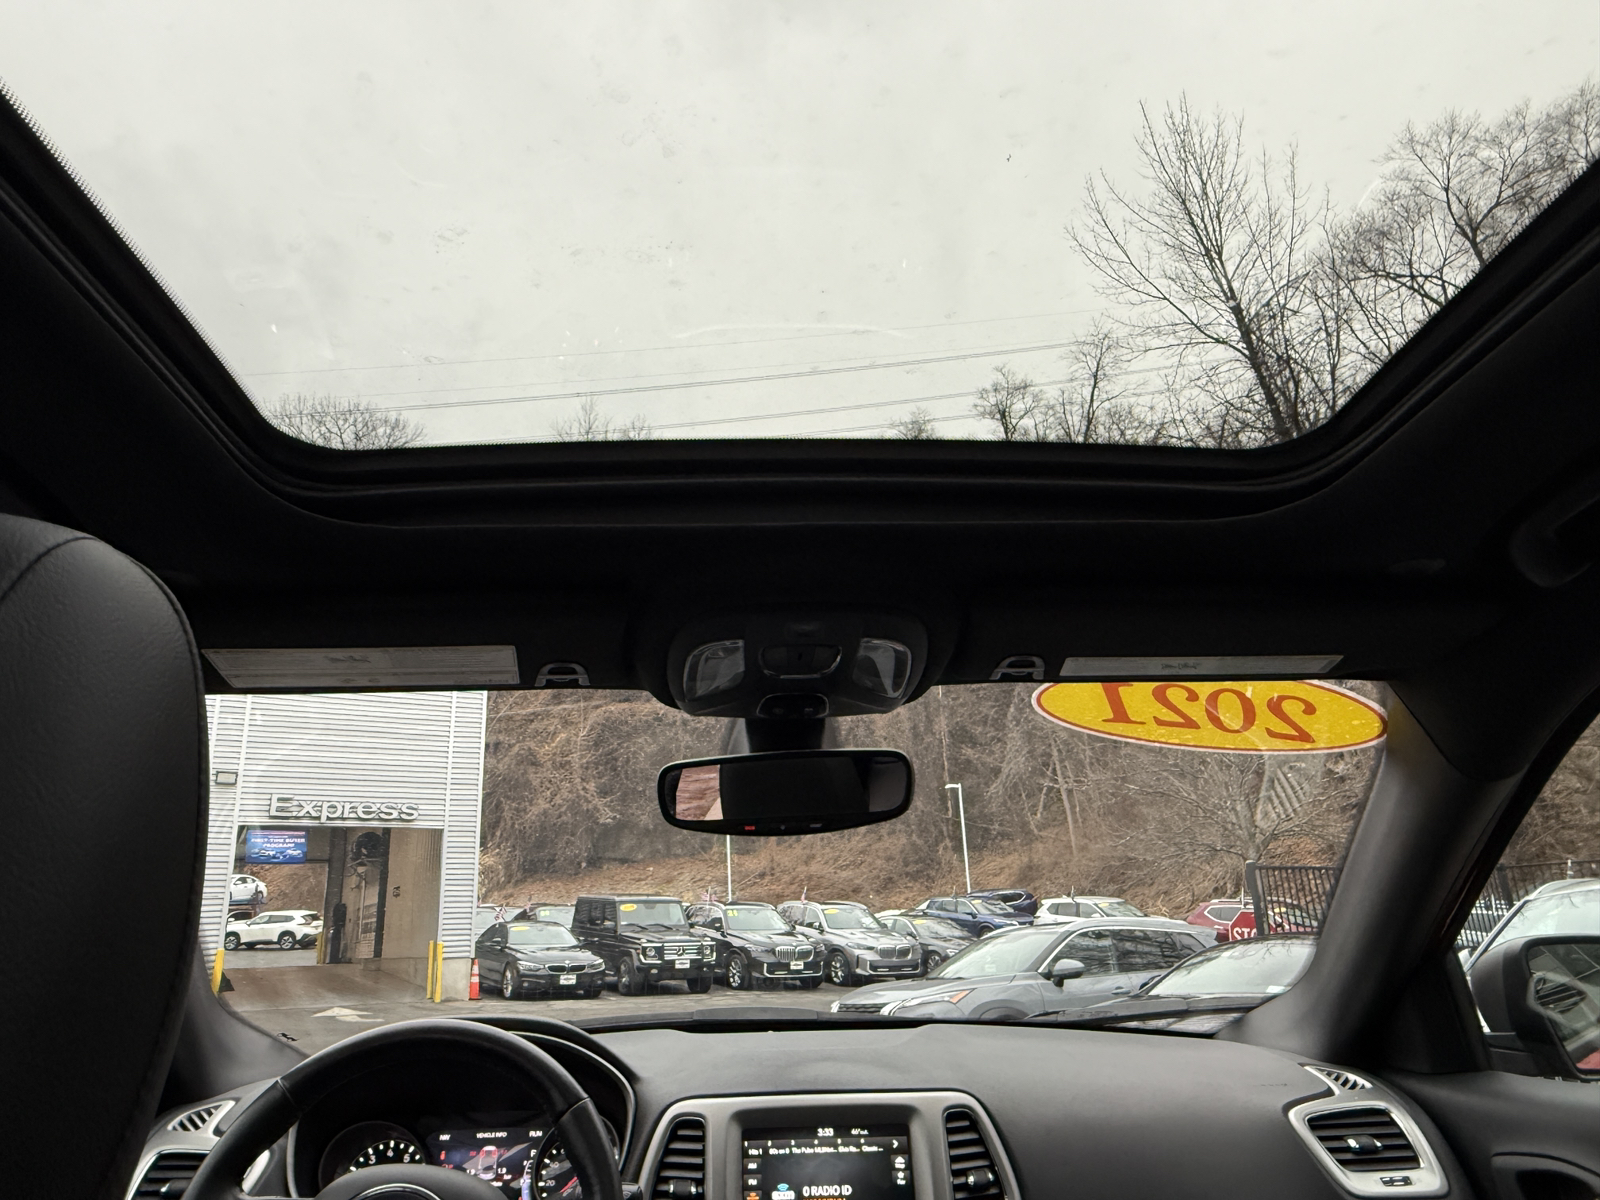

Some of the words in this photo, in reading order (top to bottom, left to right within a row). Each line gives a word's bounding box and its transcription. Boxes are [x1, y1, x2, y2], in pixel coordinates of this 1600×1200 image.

[269, 793, 419, 823] Express
[817, 1127, 834, 1136] 3:33
[386, 1149, 394, 1158] 4
[403, 1153, 411, 1163] 5
[368, 1155, 376, 1165] 3
[545, 1179, 556, 1187] 20
[802, 1185, 810, 1197] 0
[810, 1185, 841, 1197] RADIO
[841, 1184, 853, 1196] ID
